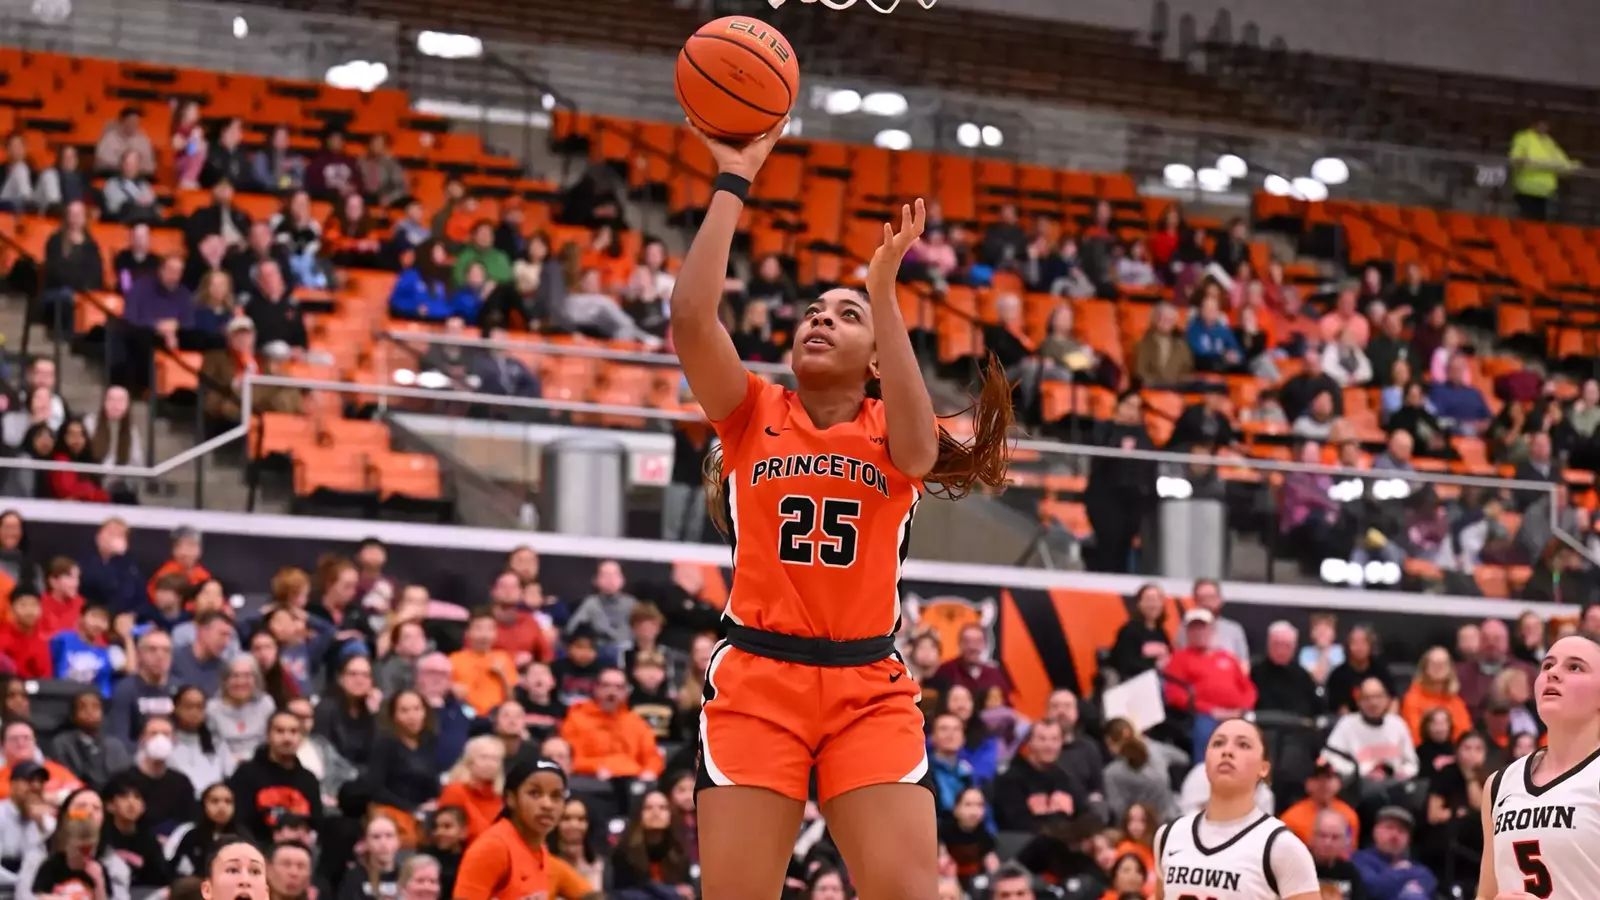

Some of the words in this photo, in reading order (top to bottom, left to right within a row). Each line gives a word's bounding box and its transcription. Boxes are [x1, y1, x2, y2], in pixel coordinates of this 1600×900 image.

[728, 20, 790, 64] ELITE
[751, 453, 890, 499] PRINCETON
[778, 493, 862, 569] 25
[1166, 866, 1241, 891] BROWN
[1512, 839, 1554, 900] 5
